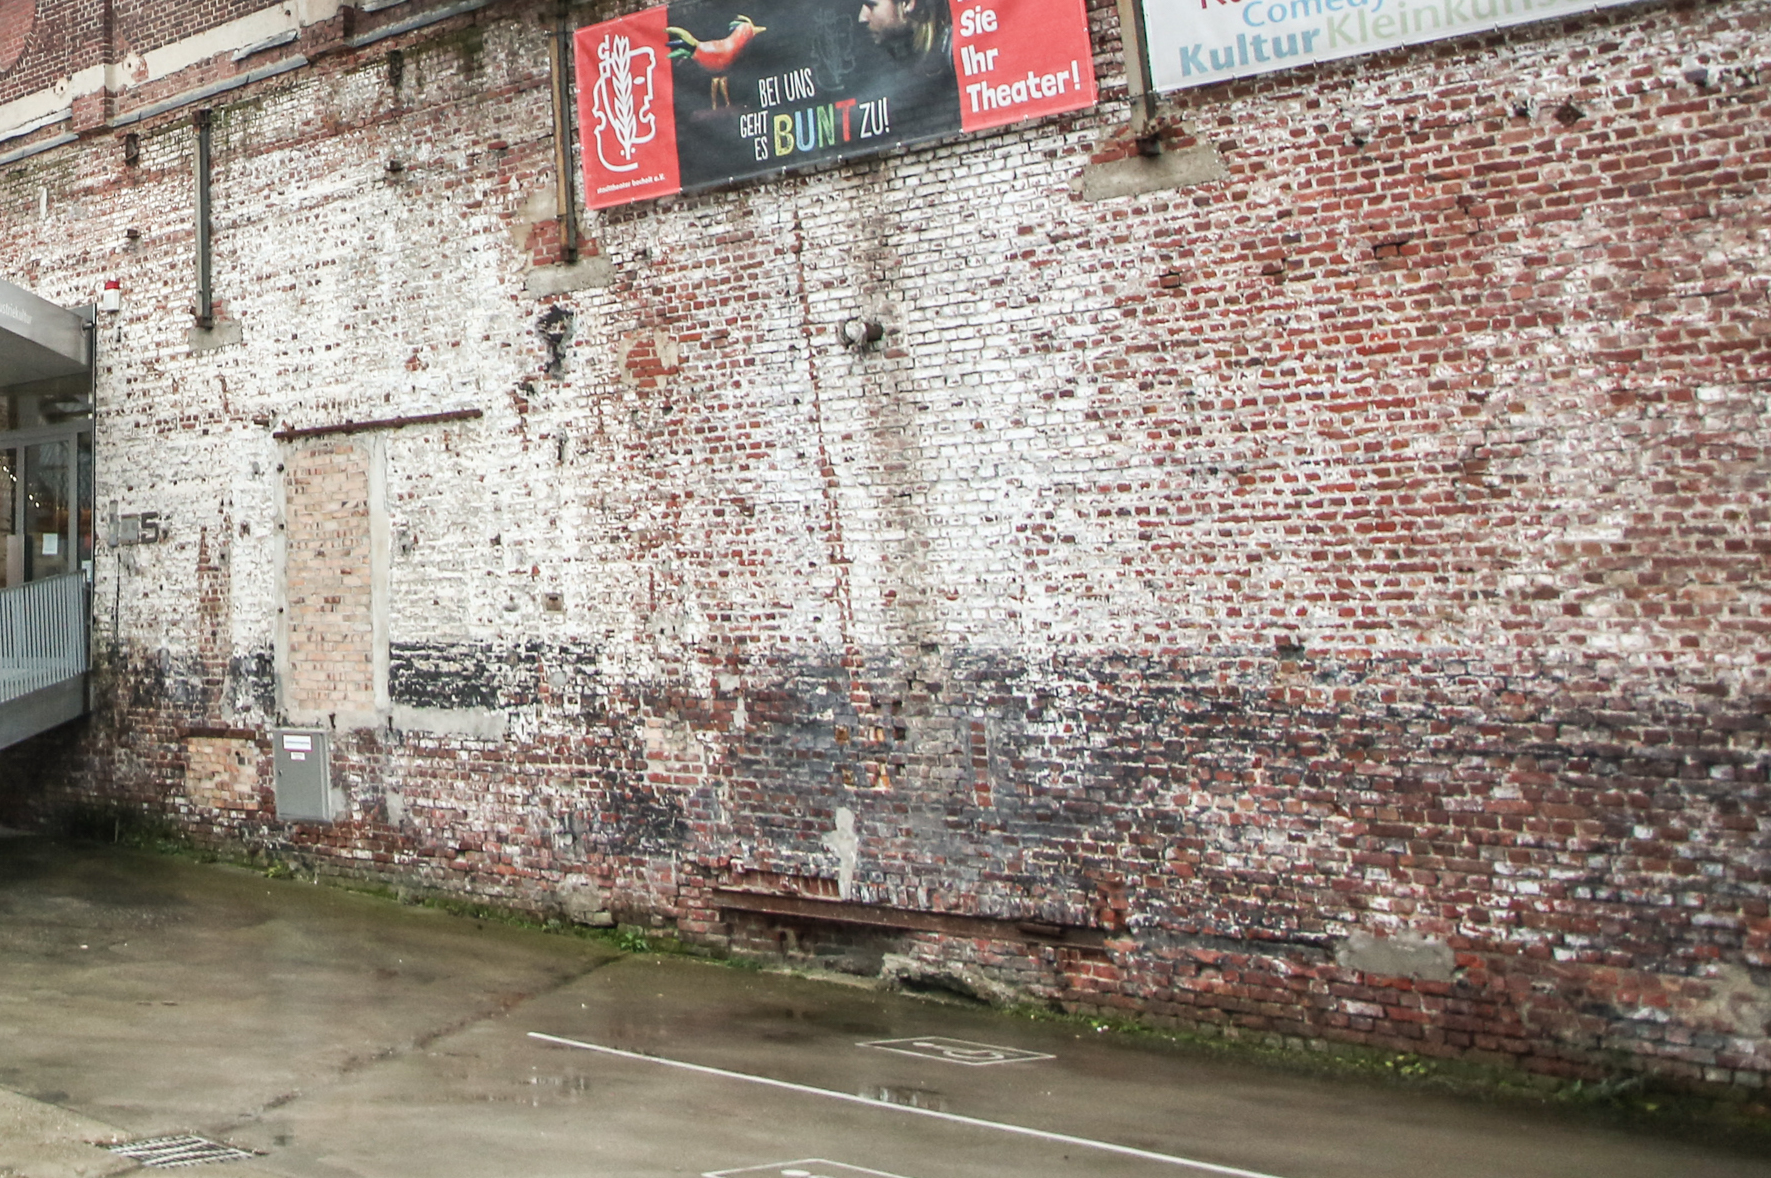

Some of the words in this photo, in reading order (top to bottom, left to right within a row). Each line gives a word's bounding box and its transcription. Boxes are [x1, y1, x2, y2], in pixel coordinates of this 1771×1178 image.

[959, 5, 998, 37] Sie
[960, 44, 999, 76] Ihr
[1179, 25, 1321, 77] Kultur
[758, 75, 781, 108] BEI
[783, 67, 816, 102] UNS
[965, 60, 1081, 113] Theater!
[739, 110, 769, 138] GEHT
[773, 98, 857, 157] BUNT
[859, 96, 890, 139] ZU!
[753, 135, 769, 161] ES
[631, 175, 653, 187] bocholt
